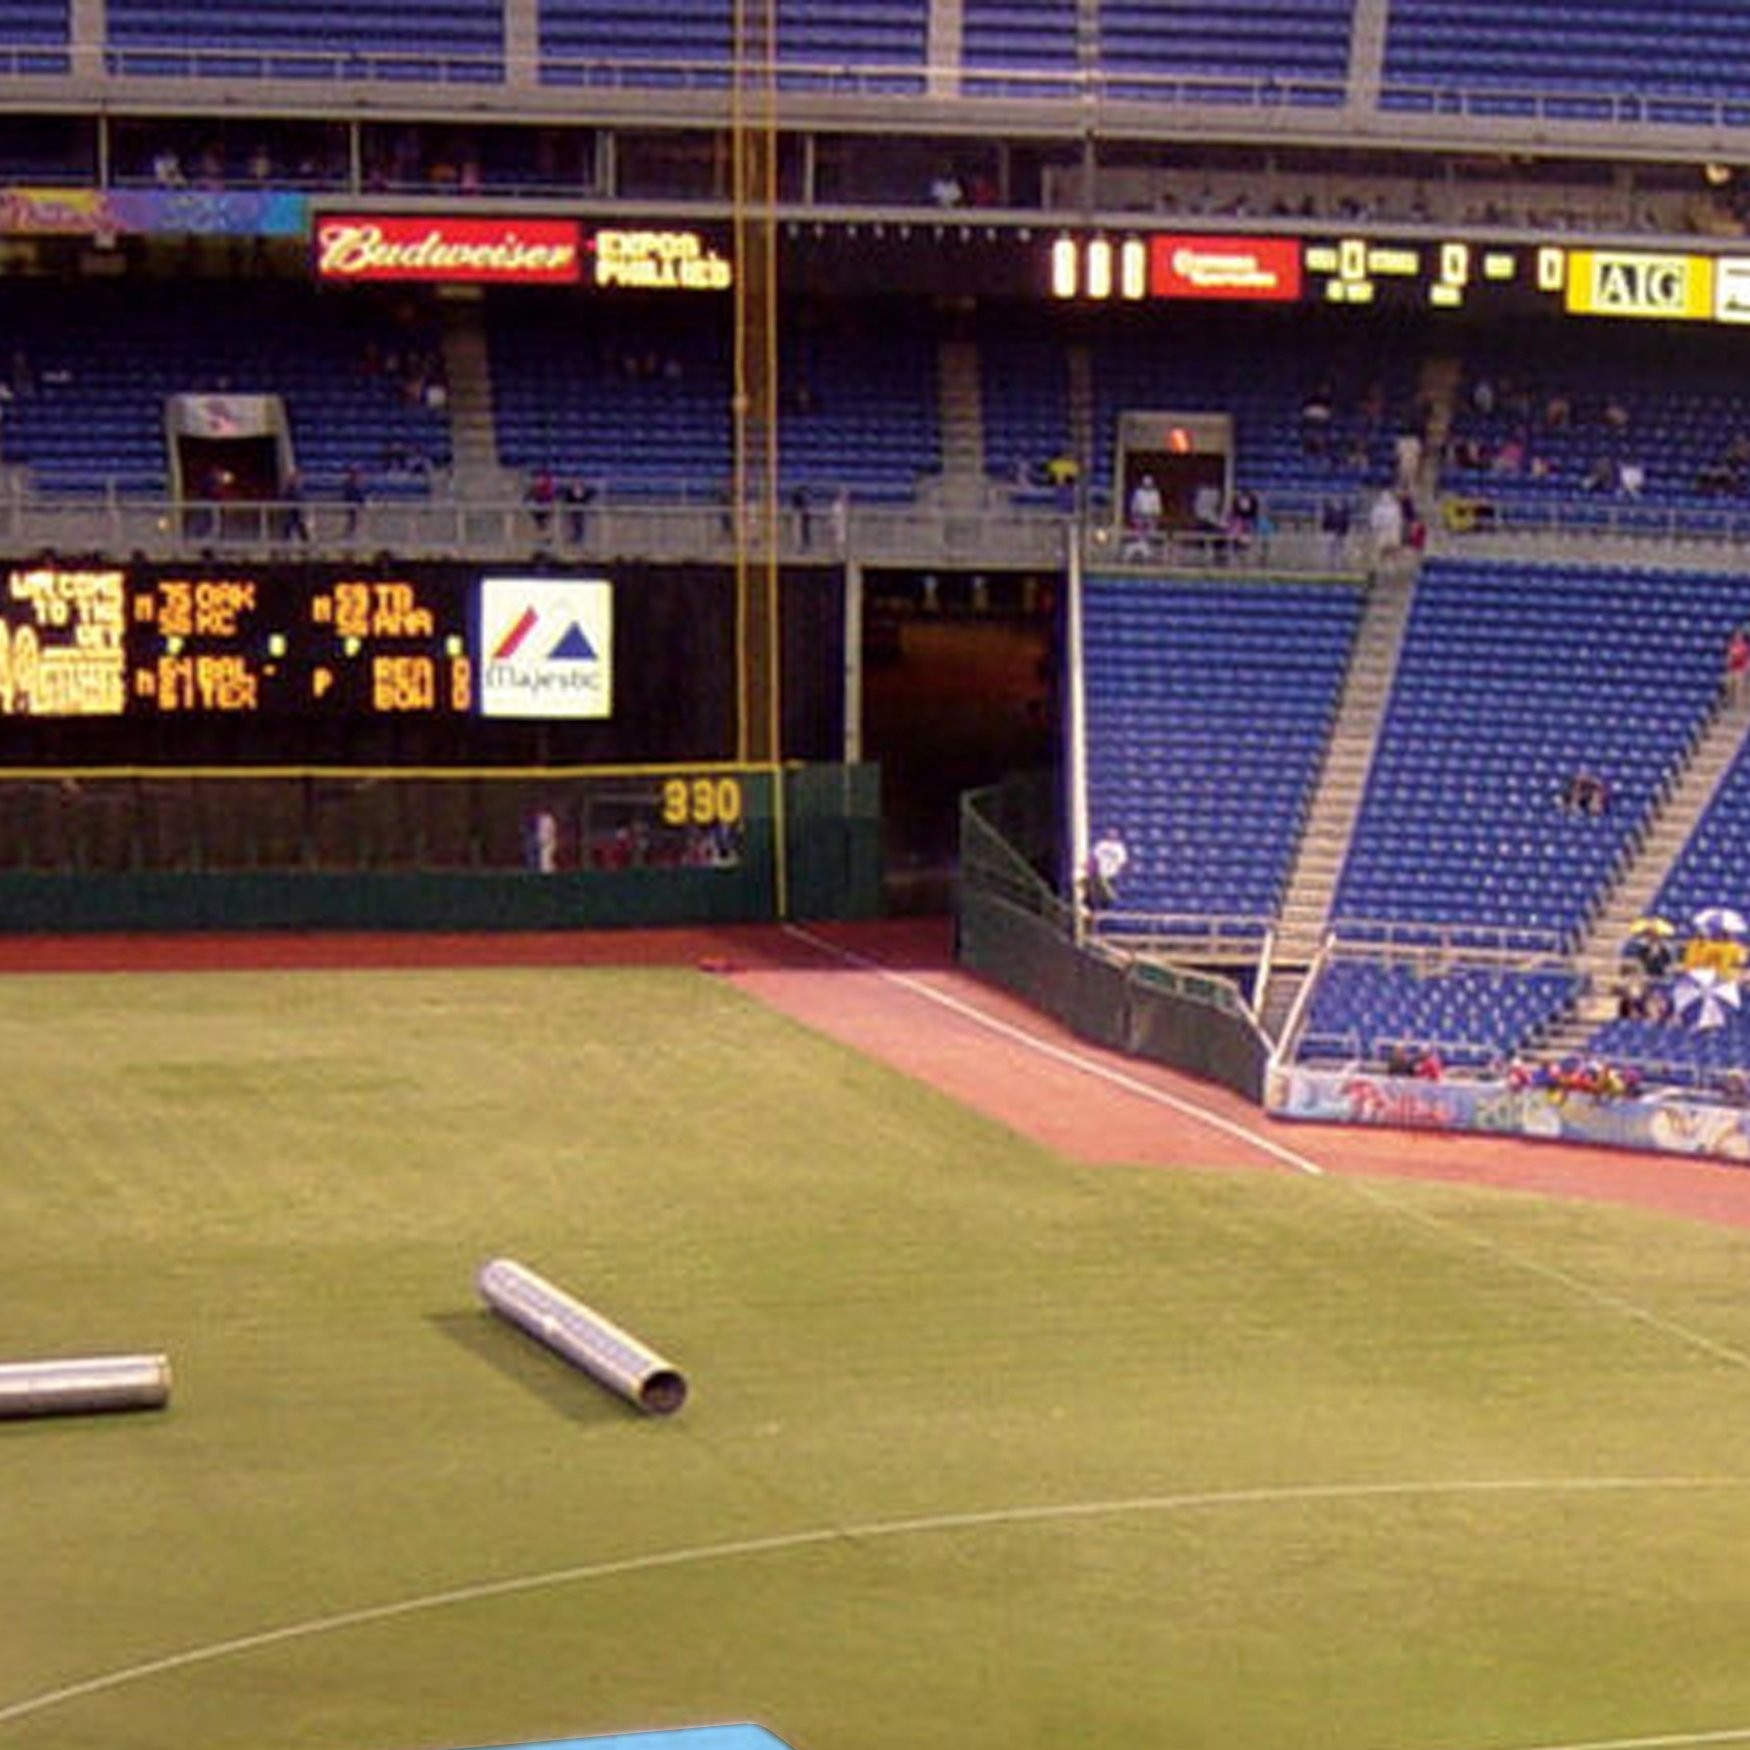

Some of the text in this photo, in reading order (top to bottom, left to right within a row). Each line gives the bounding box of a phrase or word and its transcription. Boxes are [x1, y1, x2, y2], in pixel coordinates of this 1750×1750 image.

[319, 223, 574, 276] Budweiser
[1598, 262, 1686, 308] AIG
[486, 665, 602, 698] Majestic
[663, 779, 740, 824] 330
